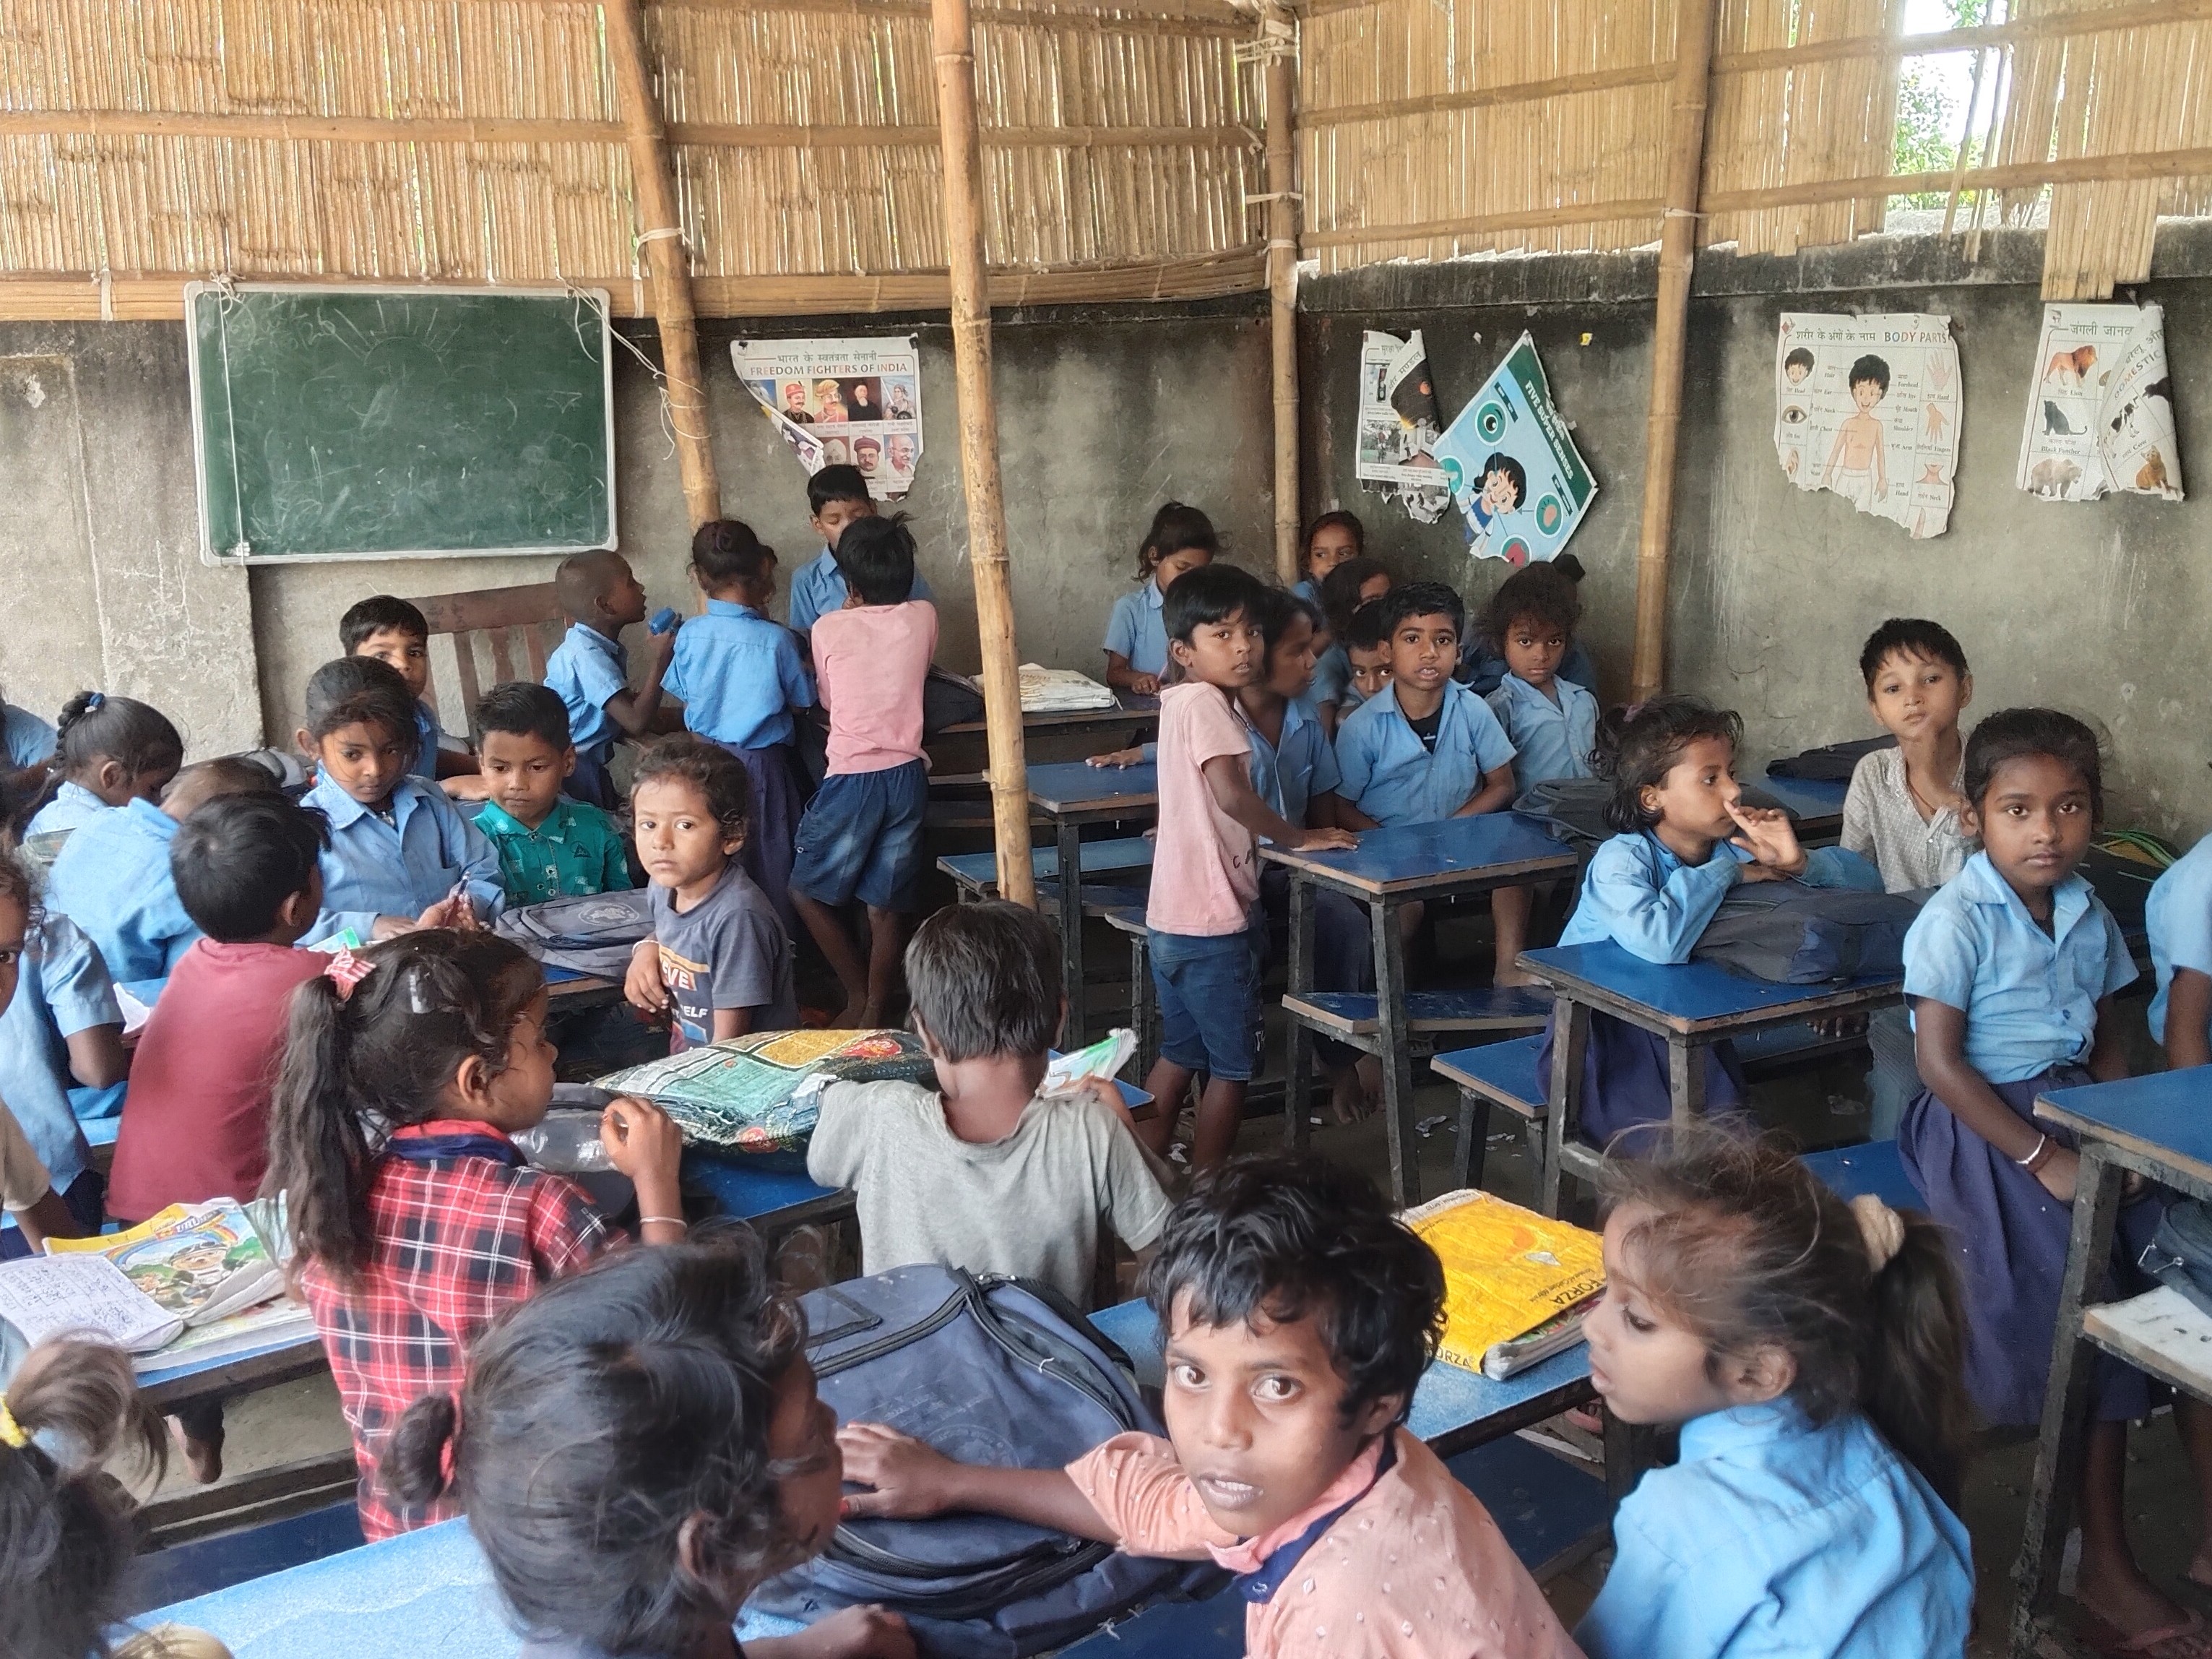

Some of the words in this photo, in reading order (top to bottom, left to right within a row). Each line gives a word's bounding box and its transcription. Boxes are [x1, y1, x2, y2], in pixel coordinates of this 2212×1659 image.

[1796, 328, 1814, 340] शरीर
[1818, 328, 1826, 340] के
[1846, 329, 1855, 340] के
[1859, 332, 1876, 341] नाम
[2070, 322, 2098, 336] जंगली
[2103, 326, 2135, 337] जानव
[1885, 332, 1916, 342] BODY
[1920, 332, 1947, 343] PARTS
[777, 354, 799, 363] भारत
[803, 351, 813, 362] के
[817, 353, 849, 362] स्वतंत्रता
[853, 350, 877, 361] सेनानी
[751, 366, 804, 376] FREEDOM
[807, 364, 857, 374] FIGHTERS
[860, 364, 875, 373] OF
[877, 363, 907, 372] INDIA
[1525, 380, 1541, 408] FIVE
[1537, 405, 1555, 441] SUPER
[1553, 439, 1573, 480] SENSES
[2058, 447, 2081, 455] Panther
[2133, 439, 2147, 451] Cow
[1550, 1278, 1603, 1305] FORZA
[1434, 1346, 1472, 1369] ORZA
